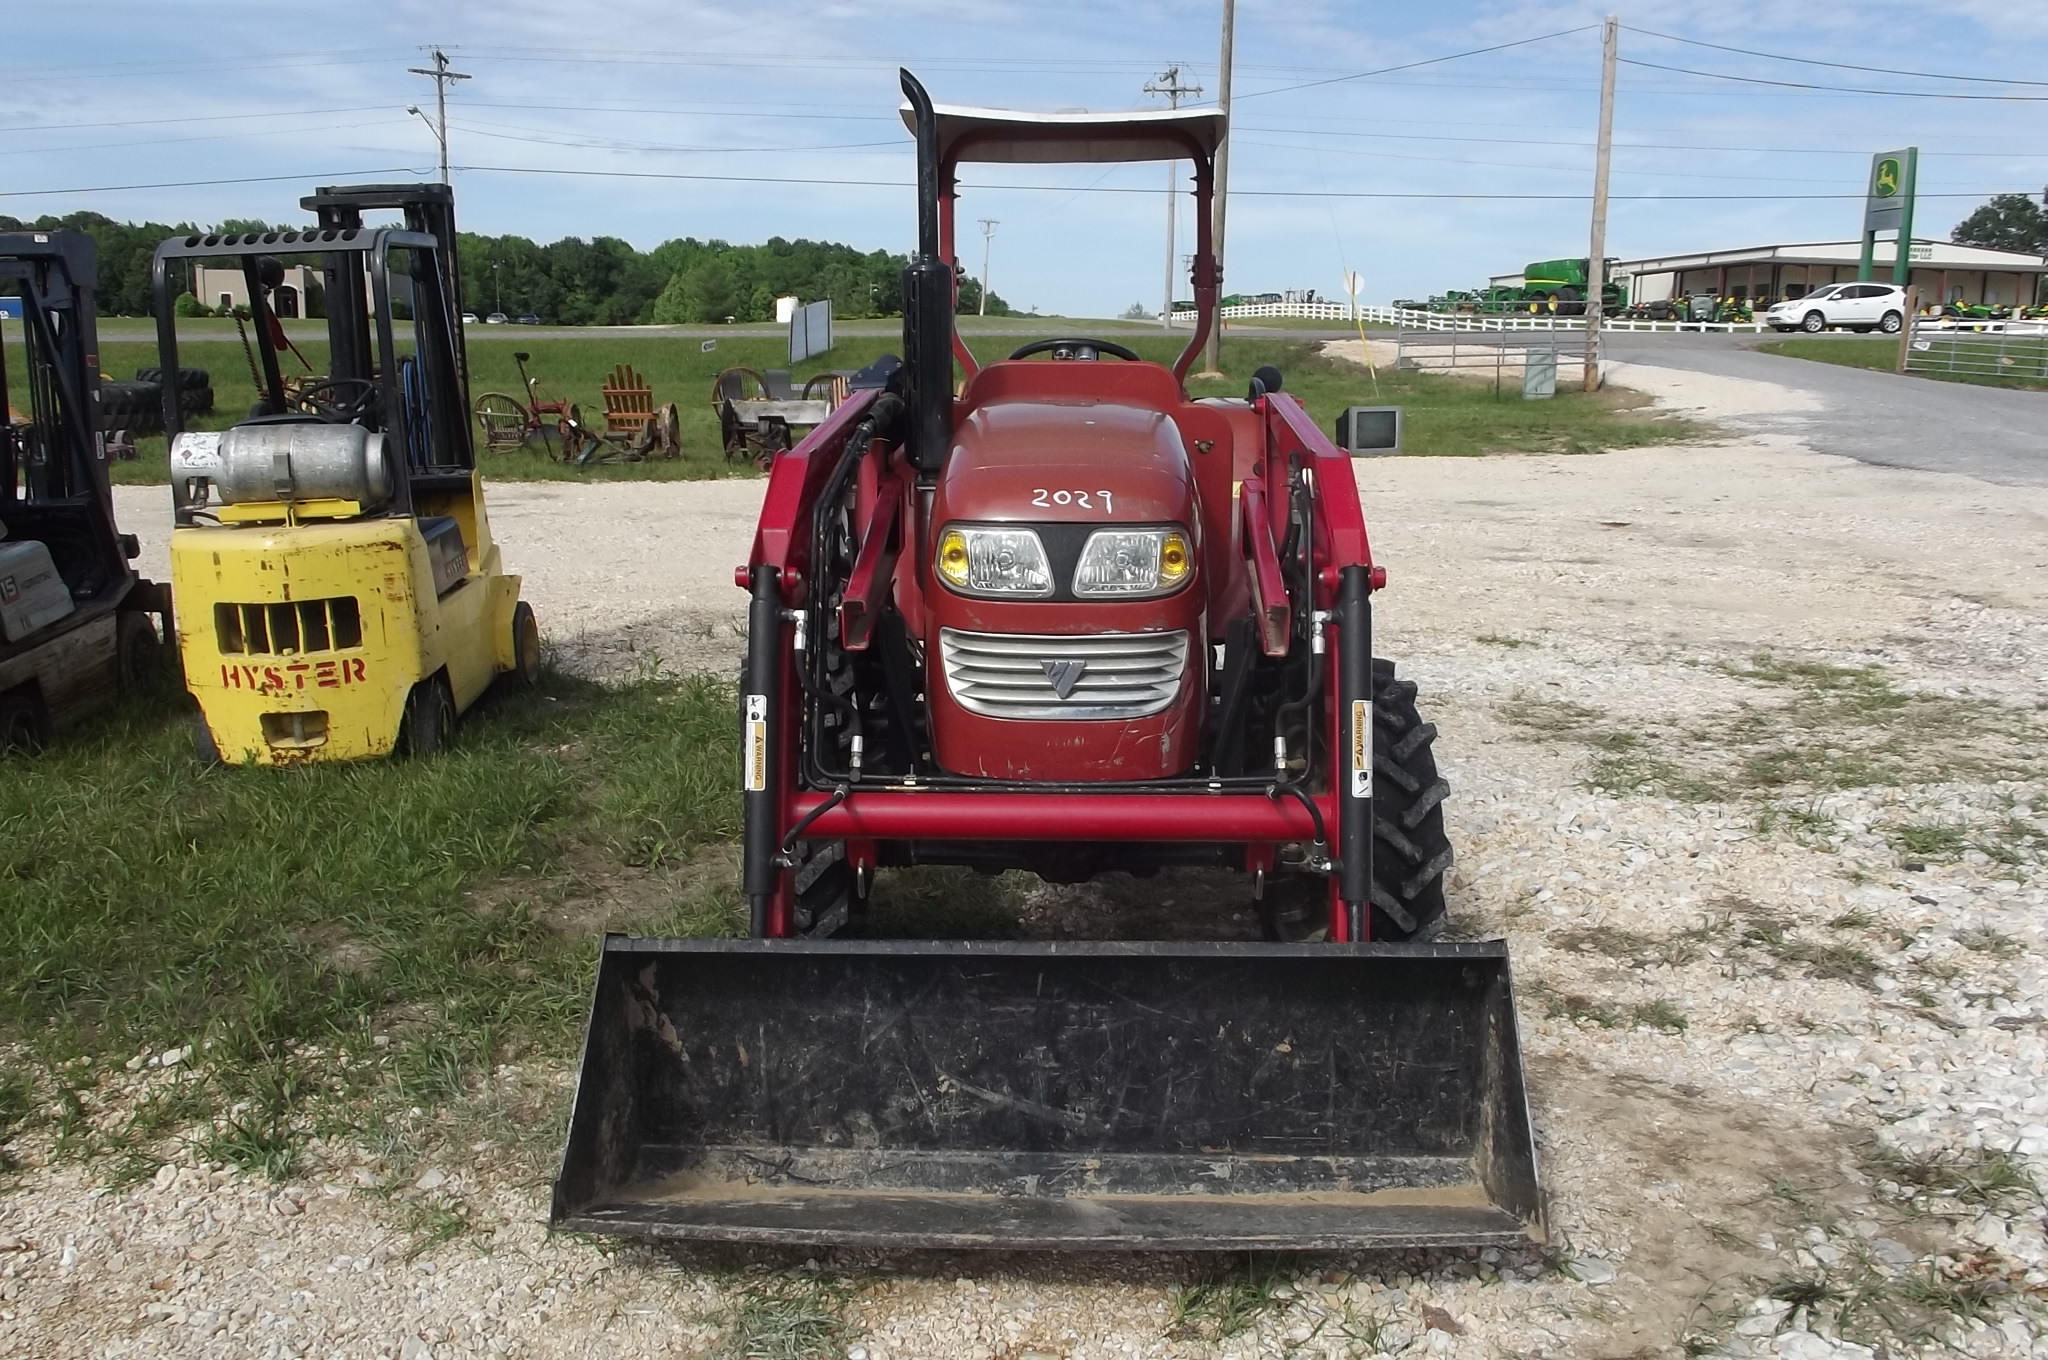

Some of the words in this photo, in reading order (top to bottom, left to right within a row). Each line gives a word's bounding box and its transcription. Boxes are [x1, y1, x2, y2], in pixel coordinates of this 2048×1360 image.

[1031, 488, 1113, 515] 2029
[221, 657, 366, 692] HYSTER
[1355, 711, 1363, 746] WARNING
[755, 744, 763, 781] WARNING
